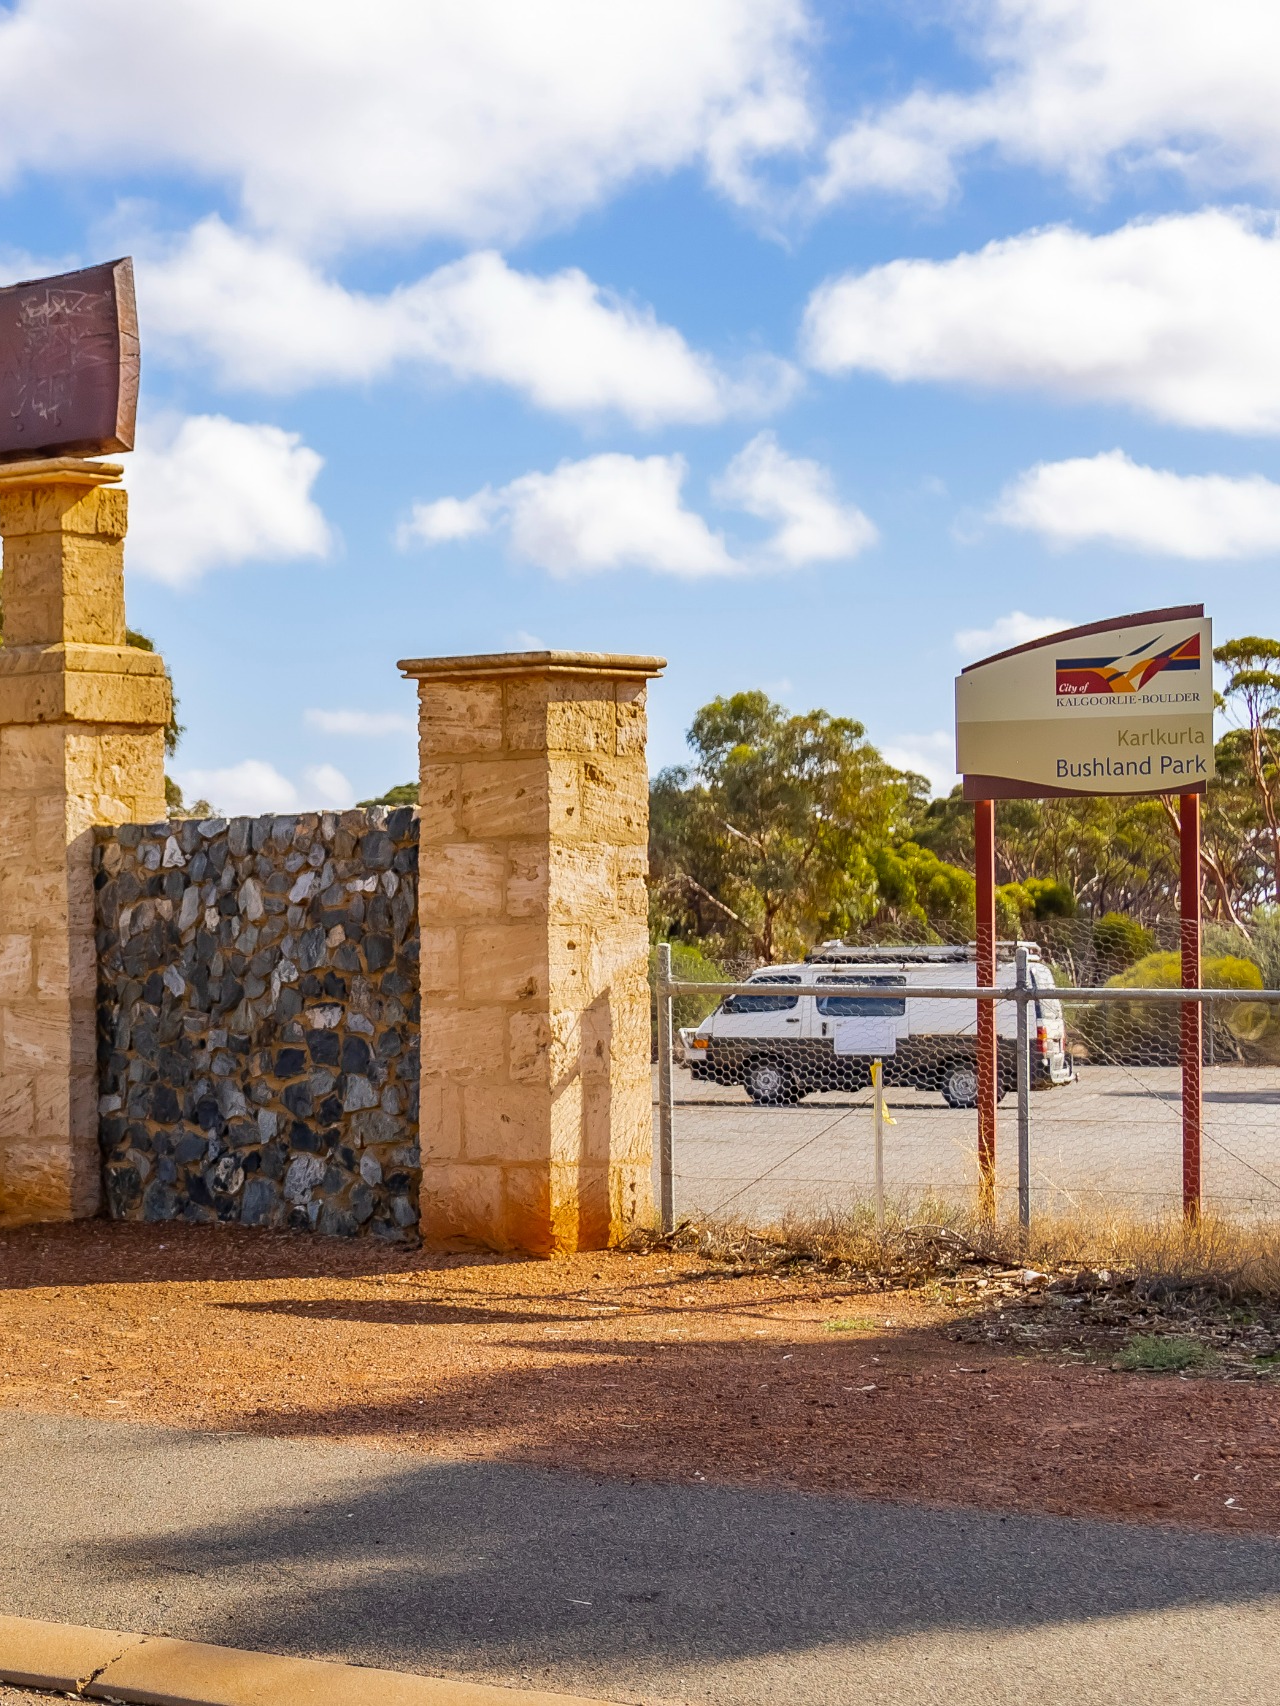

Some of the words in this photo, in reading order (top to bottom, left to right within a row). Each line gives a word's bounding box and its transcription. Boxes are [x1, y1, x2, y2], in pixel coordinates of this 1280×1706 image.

[1058, 683, 1078, 694] City
[1079, 682, 1090, 693] of
[1056, 692, 1201, 707] KALGOORLIE-BOULDER
[1117, 727, 1206, 747] Karlkurla
[1056, 756, 1152, 778] Bushland
[1160, 754, 1208, 775] Park
